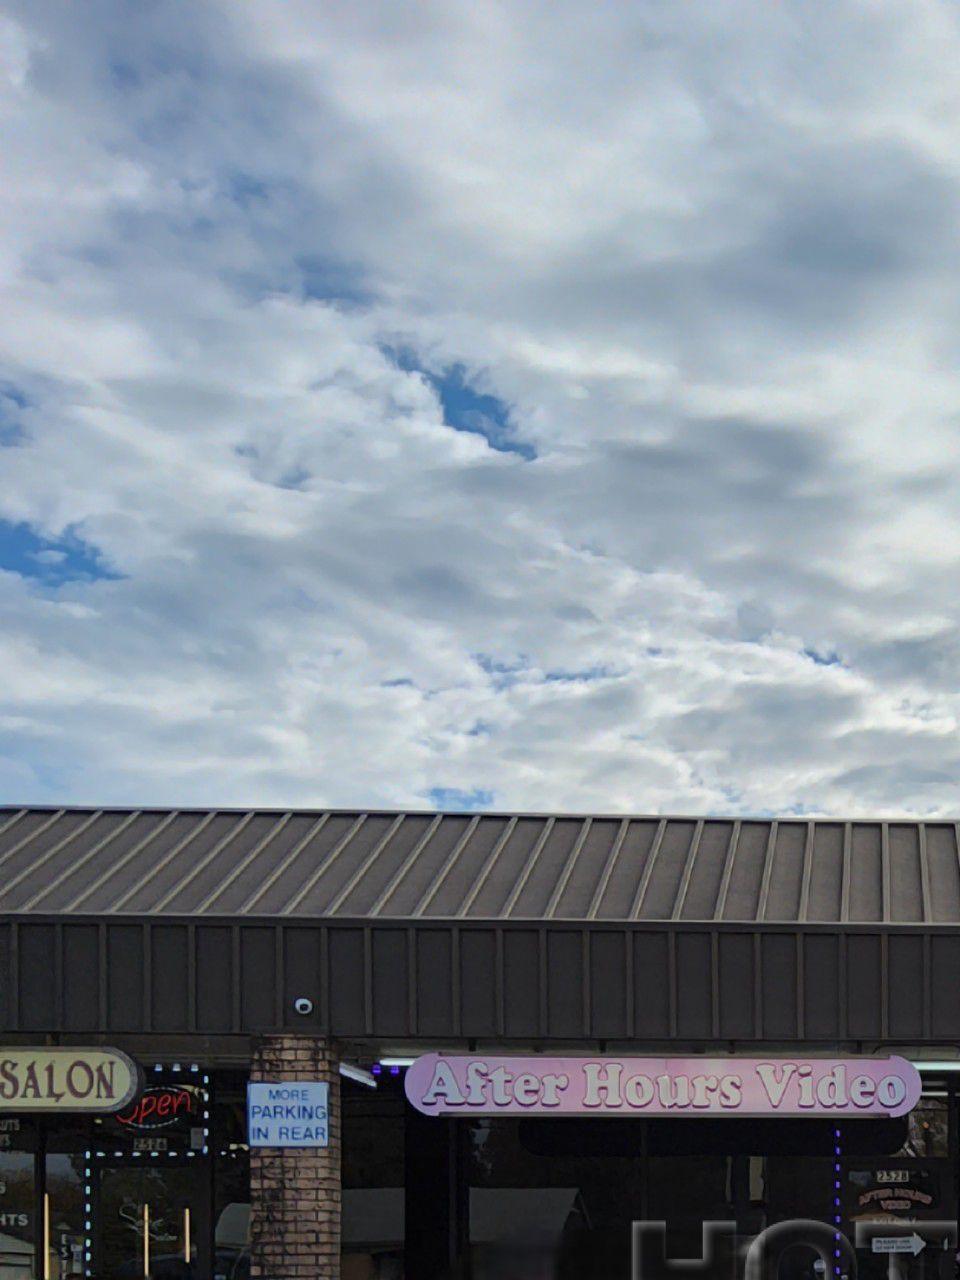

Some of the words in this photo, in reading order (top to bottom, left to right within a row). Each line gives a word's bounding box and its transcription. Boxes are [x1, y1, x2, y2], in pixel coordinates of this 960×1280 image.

[0, 1060, 116, 1102] SALON
[422, 1060, 569, 1107] After
[582, 1063, 742, 1108] Hours
[756, 1063, 906, 1108] Video
[268, 1088, 309, 1101] MORE
[251, 1105, 327, 1120] PARKING
[252, 1126, 269, 1141] IN
[278, 1126, 326, 1141] REAR
